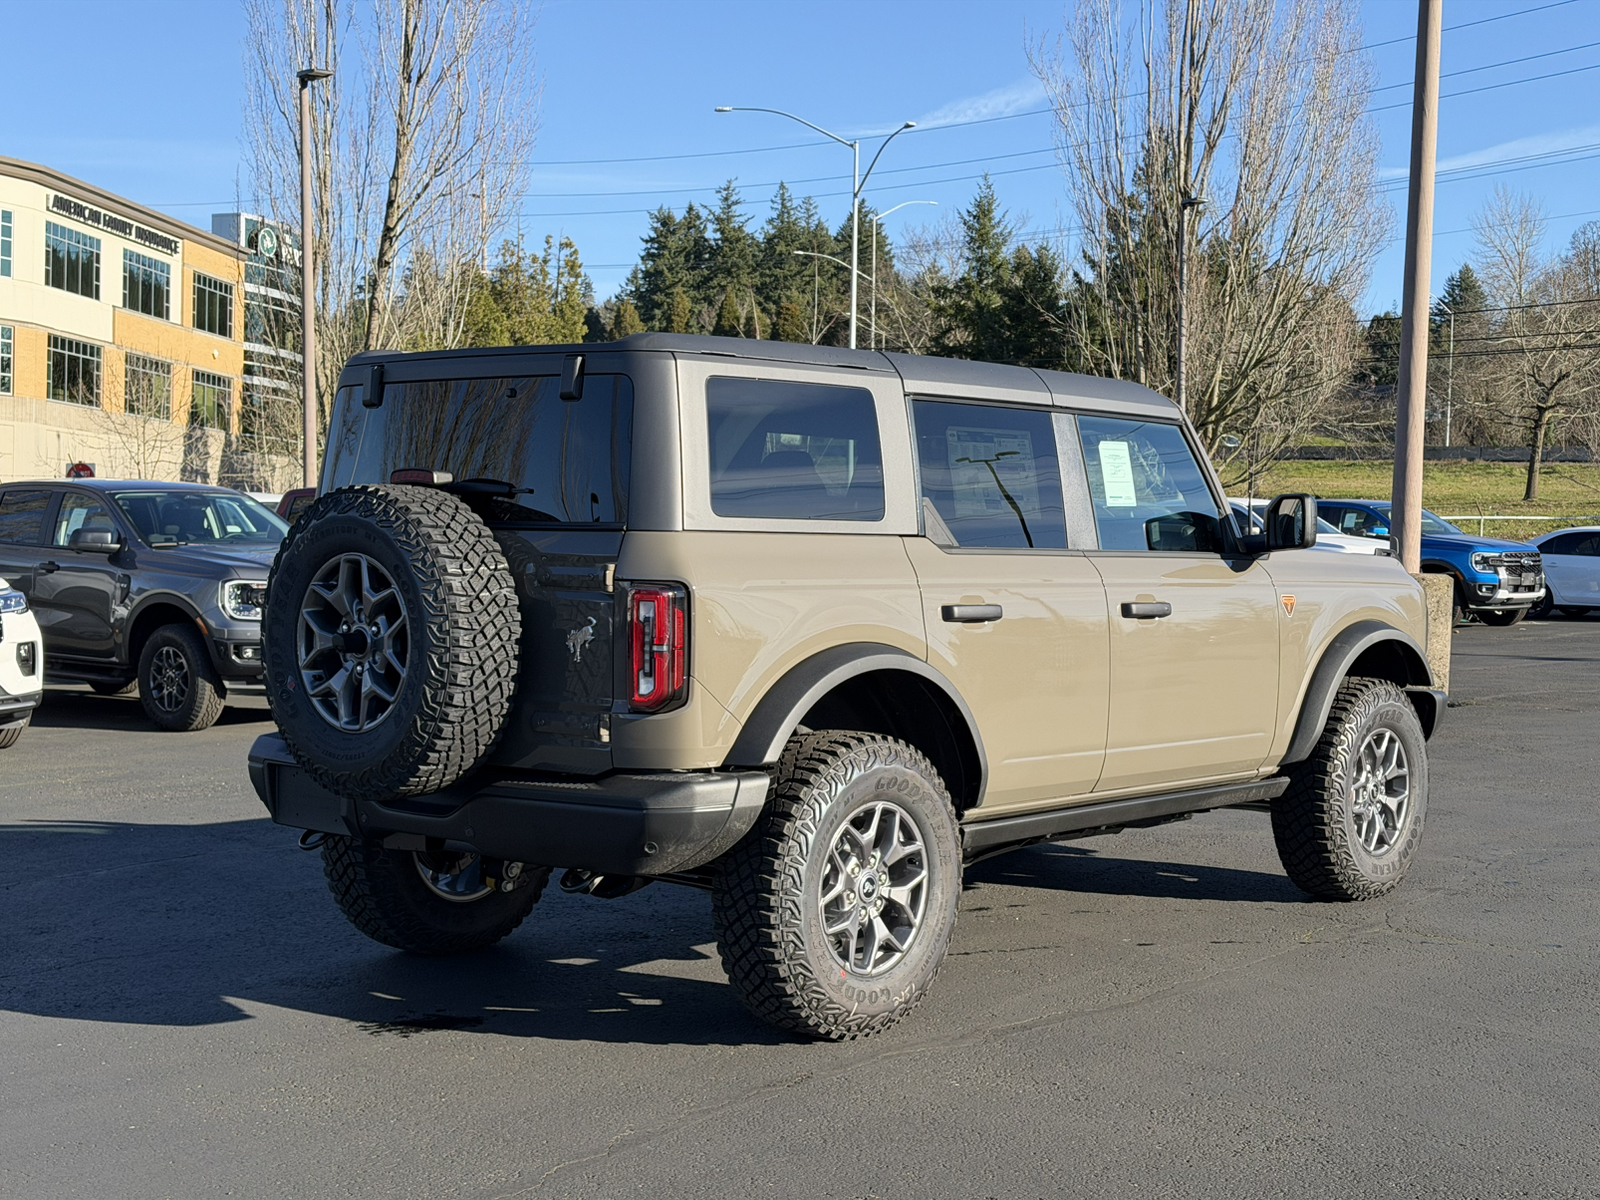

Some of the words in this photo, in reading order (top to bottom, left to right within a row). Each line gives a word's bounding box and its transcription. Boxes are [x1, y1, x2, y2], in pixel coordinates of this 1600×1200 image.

[52, 194, 102, 227] AMERICAN
[103, 212, 134, 237] FAMILY
[135, 225, 180, 254] INSURANCE
[311, 525, 358, 545] TERRITORY
[875, 776, 953, 867] GOODYEAR
[809, 918, 891, 1004] GOODYEAR
